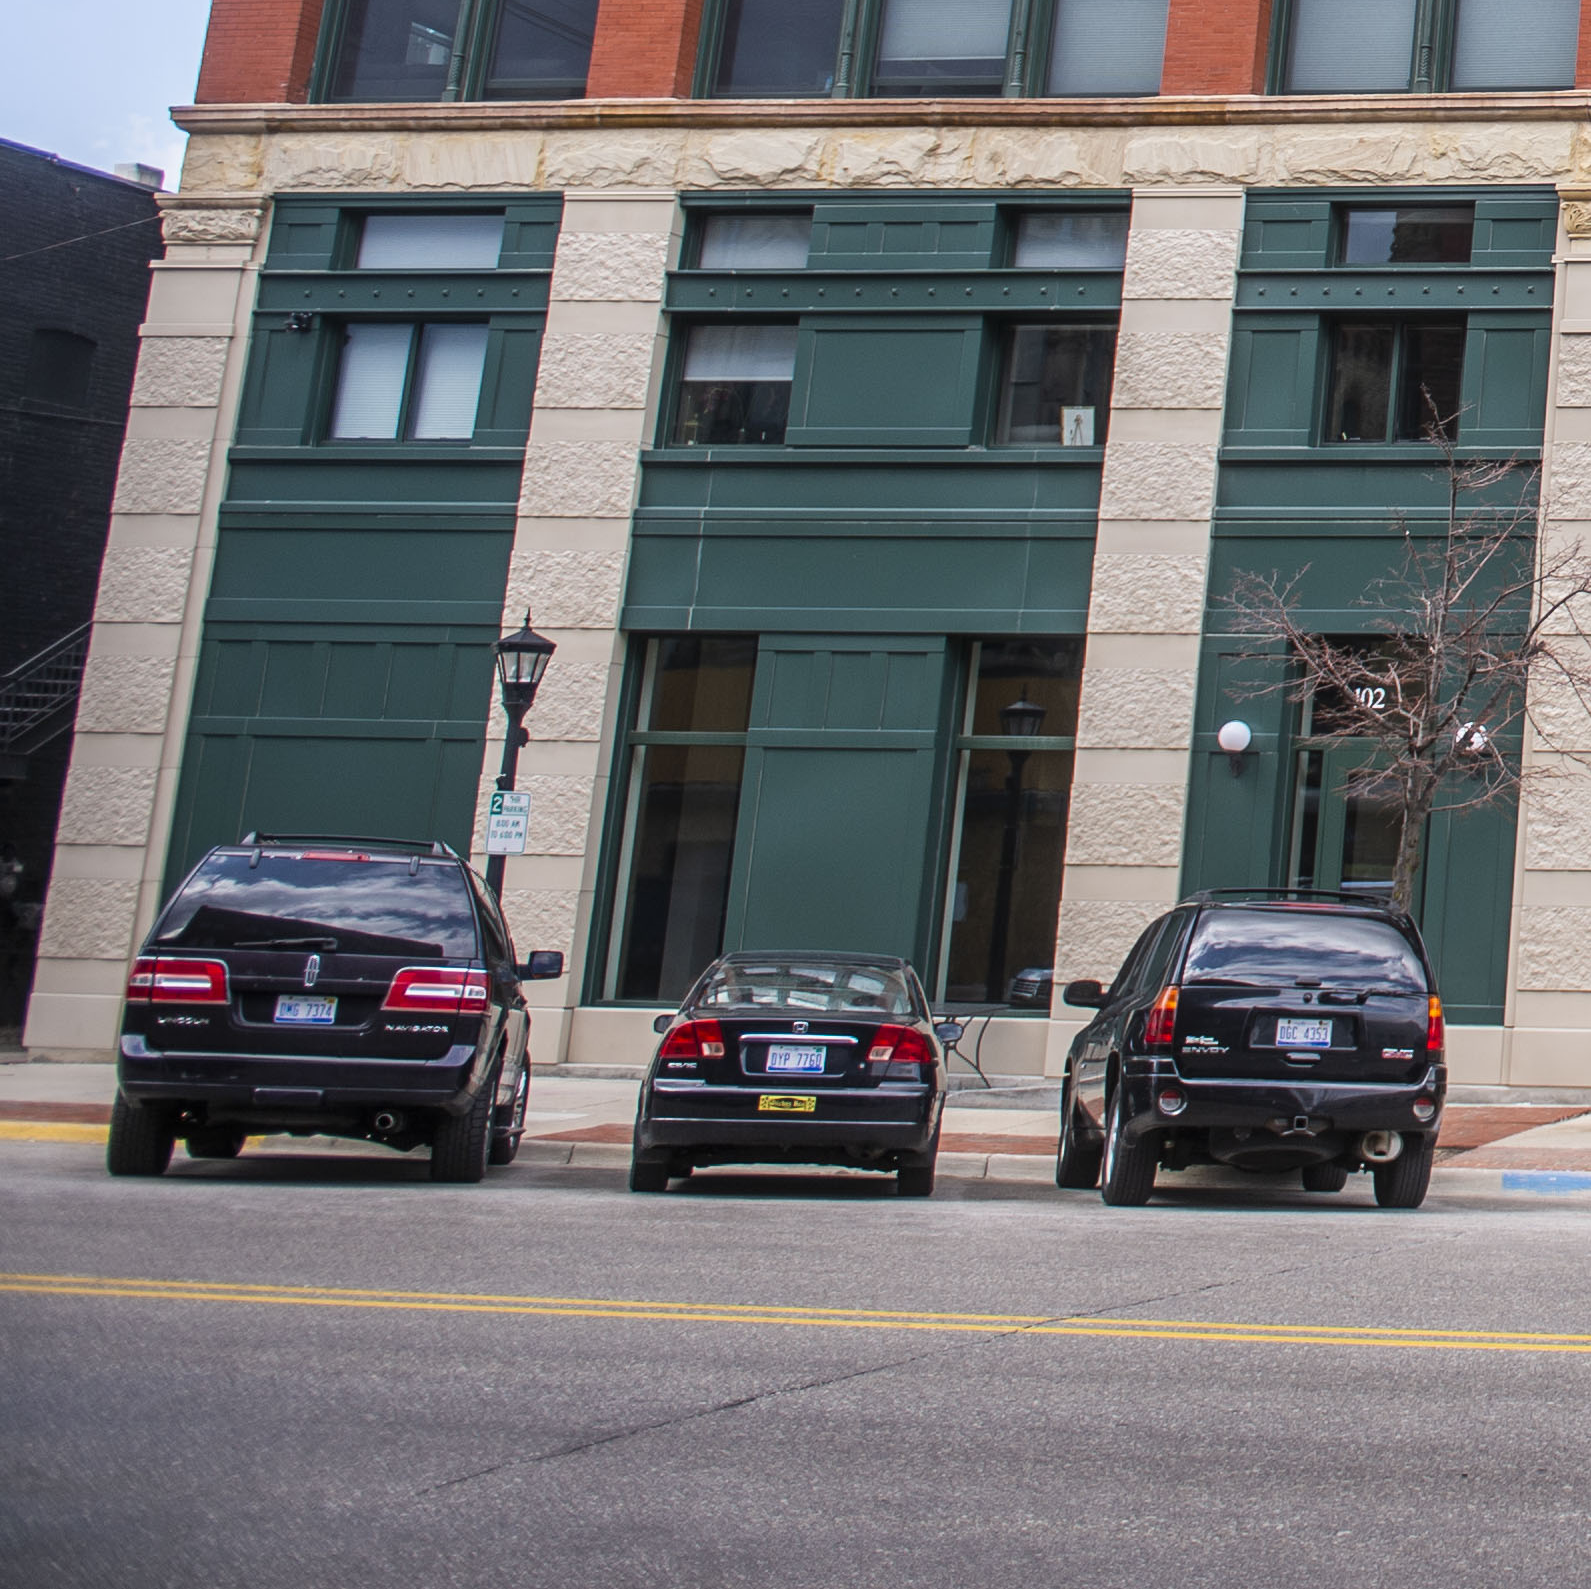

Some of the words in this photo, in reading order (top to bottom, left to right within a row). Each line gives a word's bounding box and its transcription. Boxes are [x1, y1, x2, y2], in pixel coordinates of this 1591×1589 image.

[492, 795, 503, 812] 2
[305, 1003, 332, 1017] 7374
[384, 1024, 449, 1033] NAVIGATOR
[1279, 1026, 1298, 1040] DGC
[1303, 1027, 1328, 1041] 4353
[1182, 1046, 1230, 1054] ENVOY
[771, 1053, 791, 1066] DYP
[797, 1053, 821, 1067] 7760
